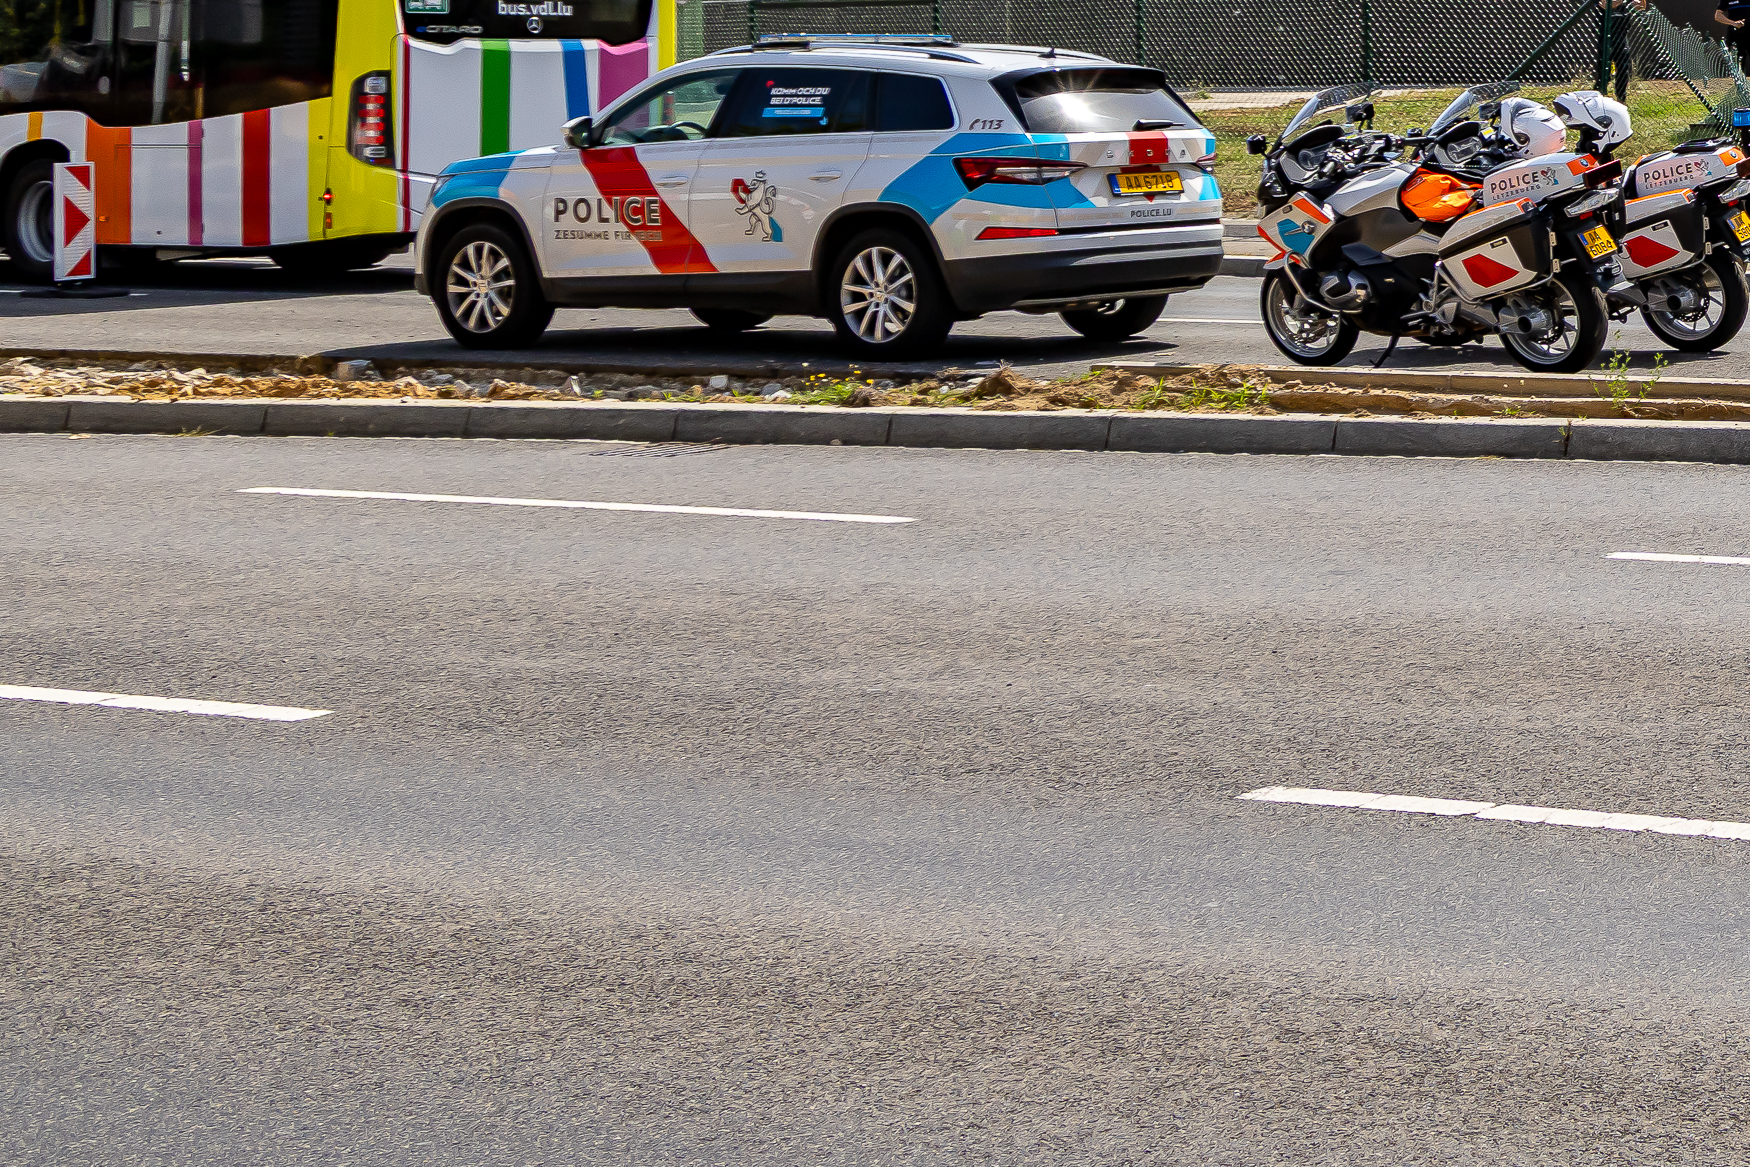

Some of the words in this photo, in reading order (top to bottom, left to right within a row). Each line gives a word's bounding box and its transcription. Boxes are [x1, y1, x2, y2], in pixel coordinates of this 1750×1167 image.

[498, 0, 574, 15] bus.vdl.lu
[981, 119, 1004, 130] 113
[1644, 162, 1693, 182] POLICE
[1490, 171, 1539, 193] POLICE
[554, 197, 662, 225] POLICE
[1130, 208, 1172, 218] POLICE.LU
[554, 230, 610, 240] ZESUMME
[615, 231, 632, 241] FIR
